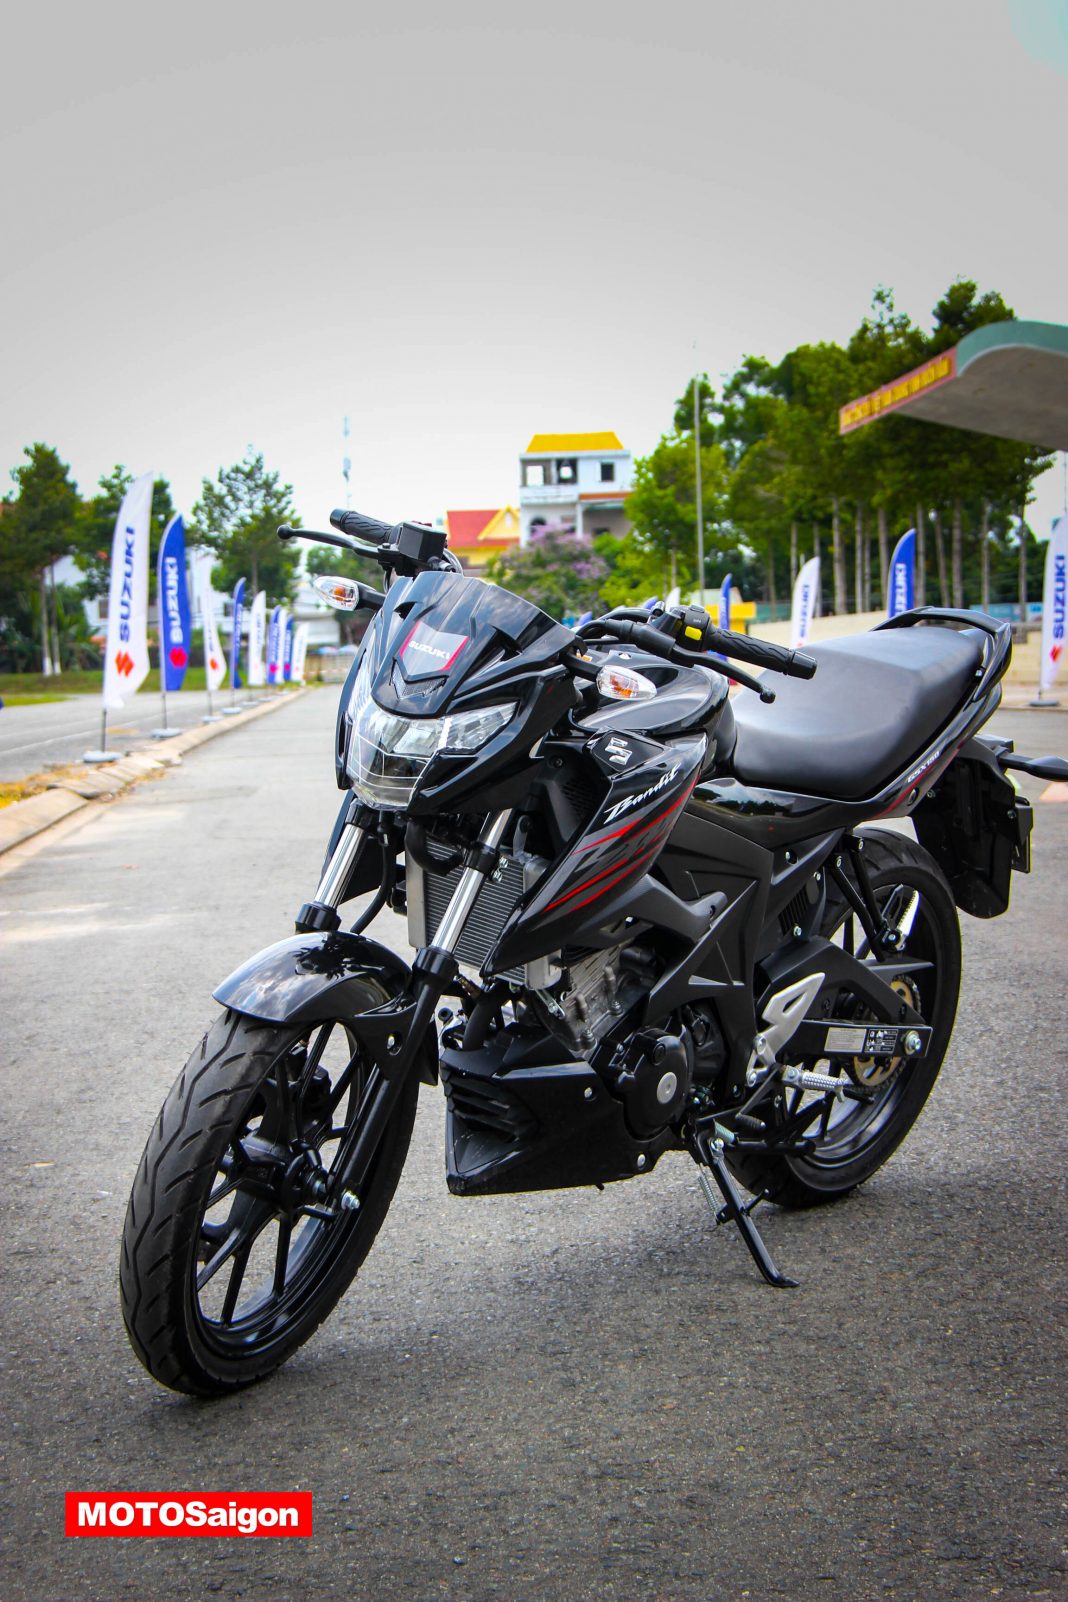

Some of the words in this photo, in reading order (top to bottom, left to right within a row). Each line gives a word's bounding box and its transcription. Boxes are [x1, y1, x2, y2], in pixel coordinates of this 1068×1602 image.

[119, 526, 136, 643] SUZUKI
[895, 563, 907, 616] UZUKI
[1053, 554, 1066, 639] SUZUKI
[408, 640, 451, 660] SUZUKI
[603, 762, 682, 825] Bandit
